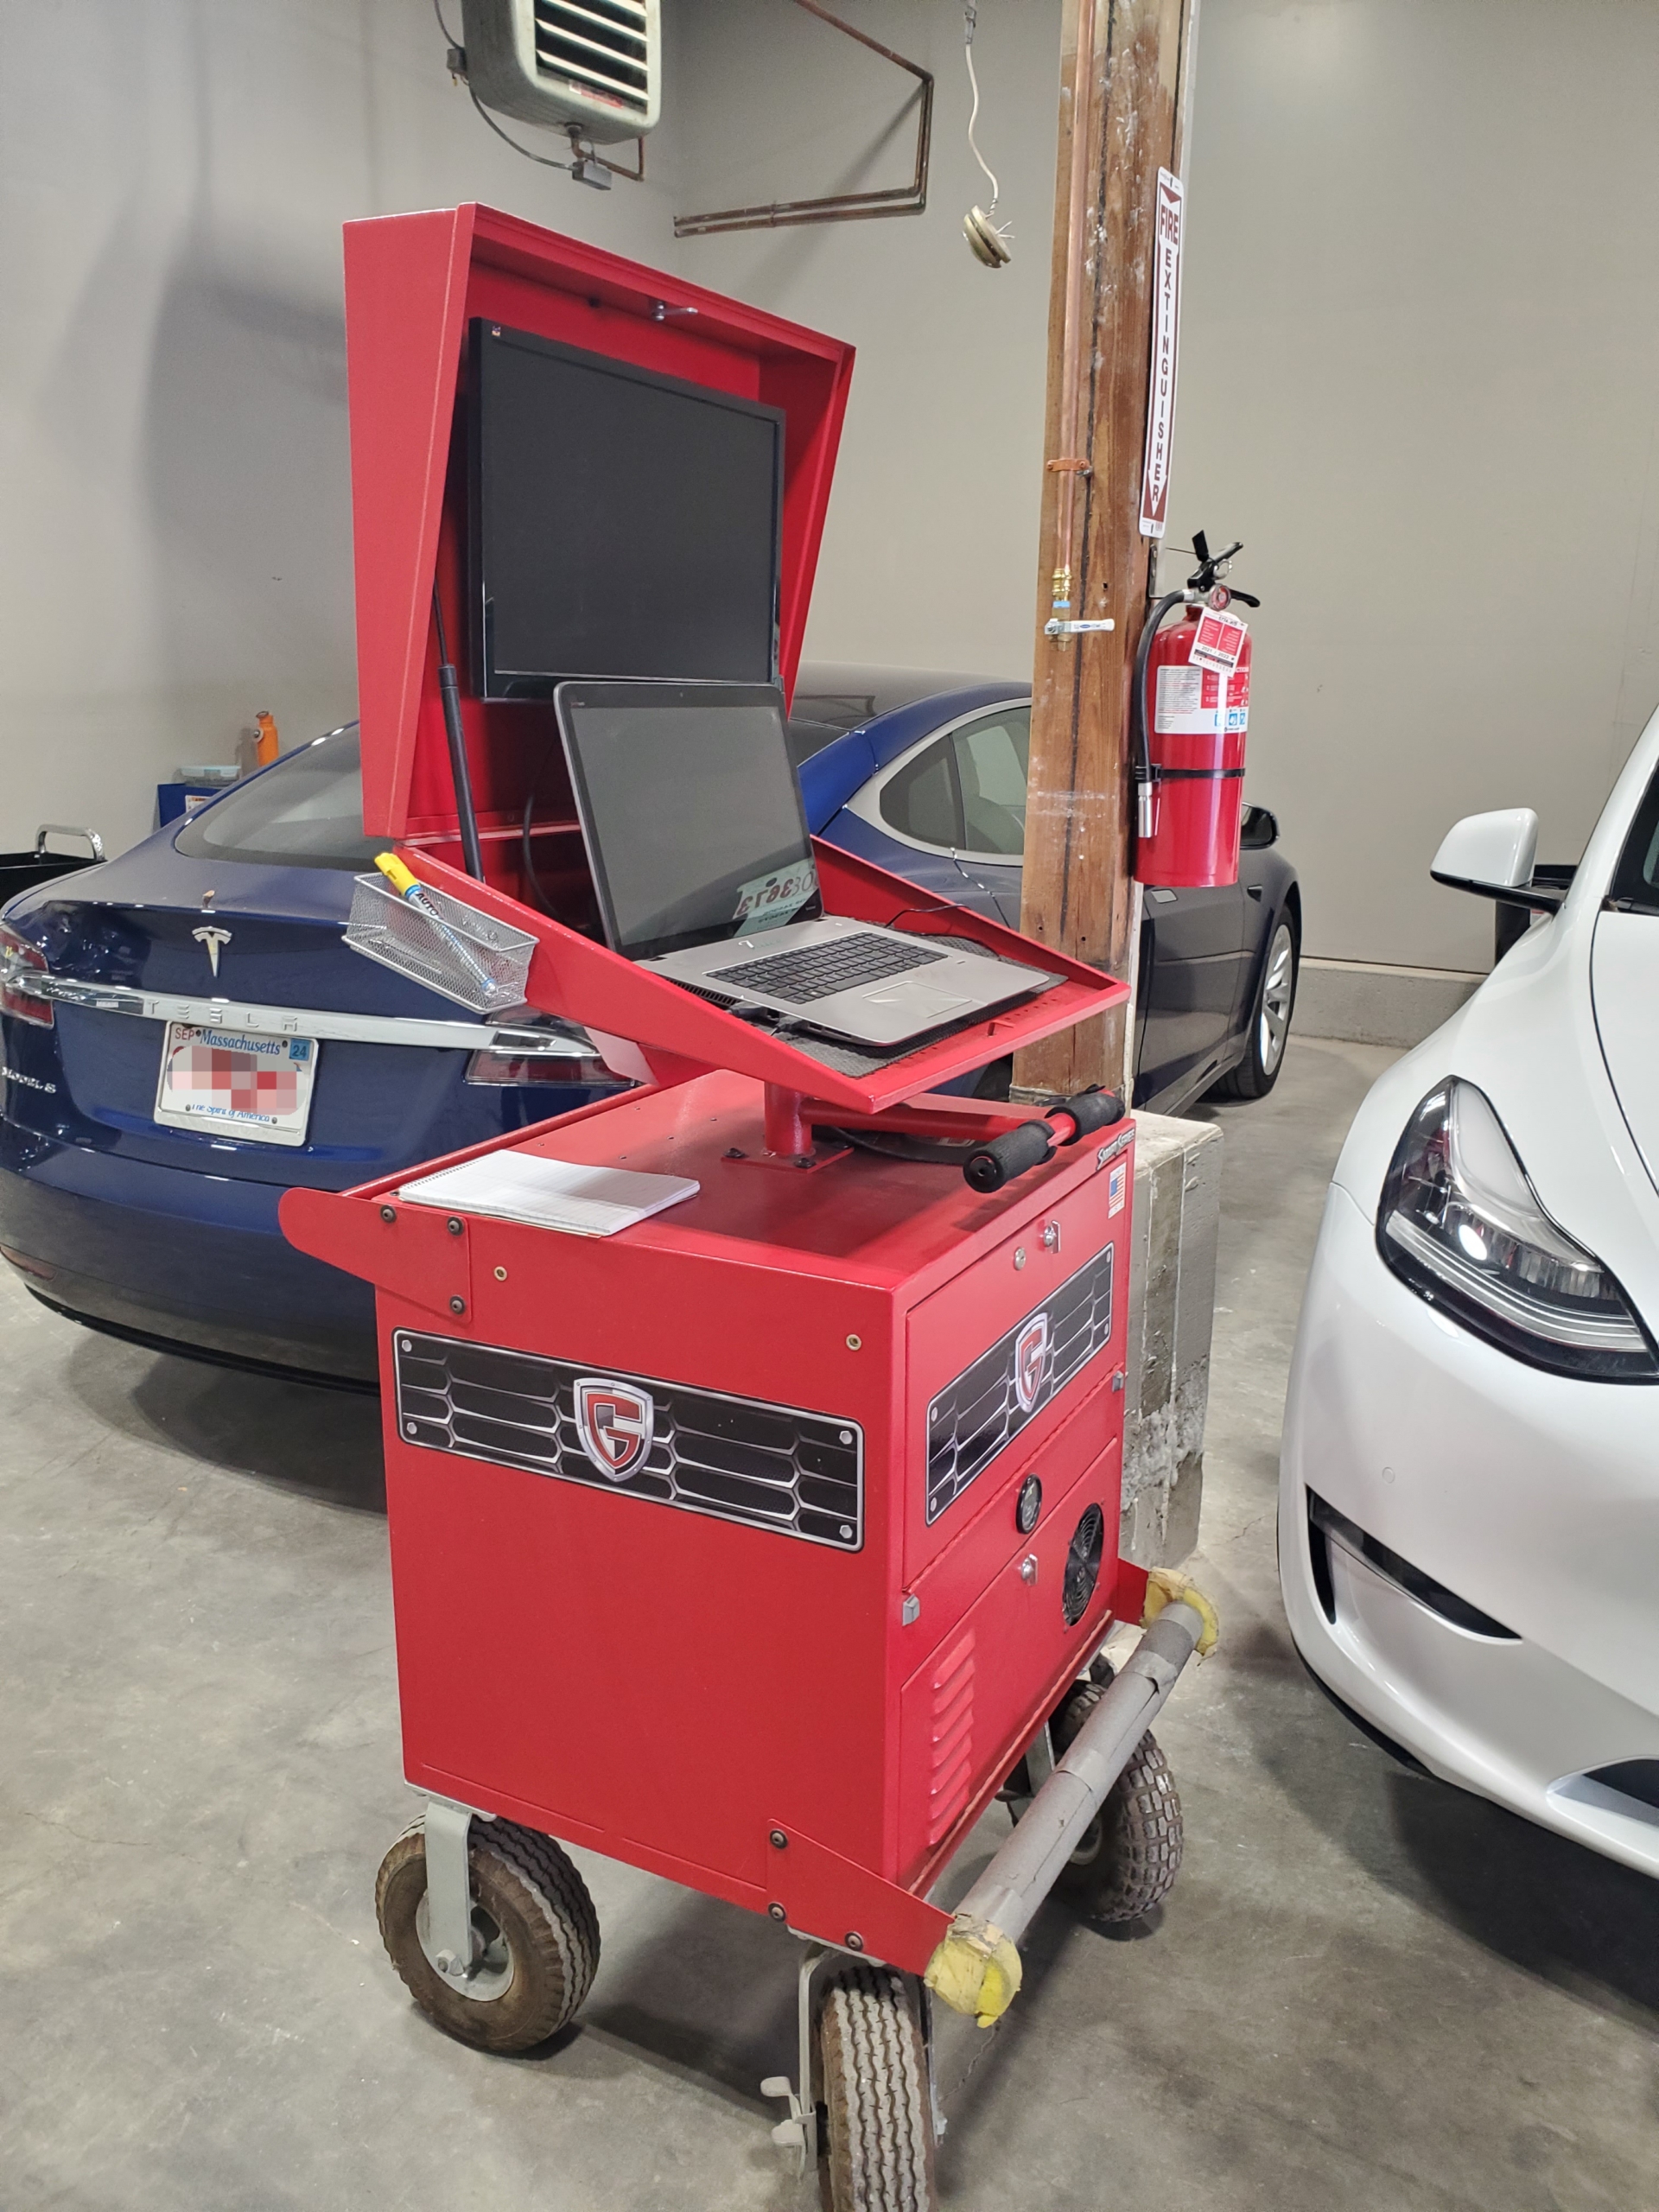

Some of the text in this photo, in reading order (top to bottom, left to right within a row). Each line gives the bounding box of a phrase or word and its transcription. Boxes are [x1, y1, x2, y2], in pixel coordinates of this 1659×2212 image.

[1160, 204, 1179, 245] FIRE
[1152, 249, 1172, 502] EXTINGUISHER
[415, 893, 439, 916] AUTO
[148, 1000, 299, 1033] TESLA
[175, 1027, 195, 1041] SEP
[200, 1029, 281, 1056] Massachusetts
[292, 1045, 307, 1058] 24
[44, 1083, 57, 1094] S
